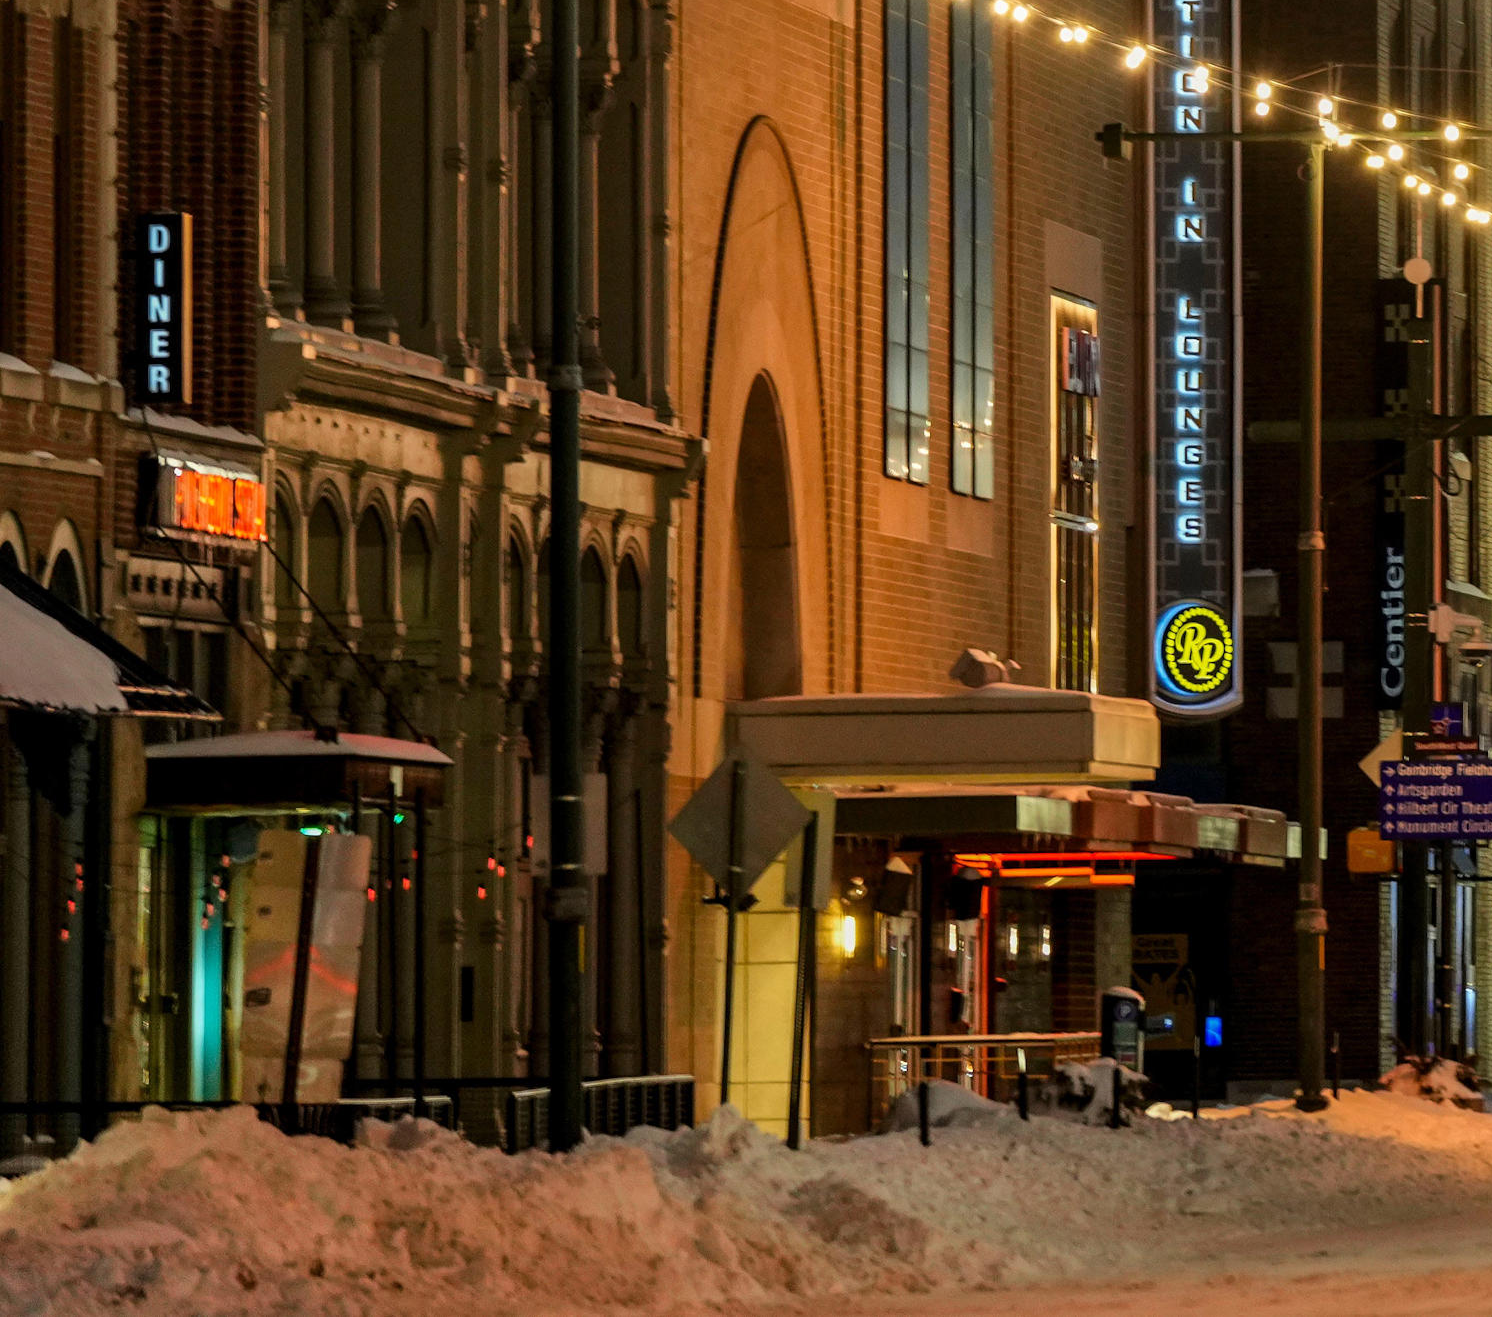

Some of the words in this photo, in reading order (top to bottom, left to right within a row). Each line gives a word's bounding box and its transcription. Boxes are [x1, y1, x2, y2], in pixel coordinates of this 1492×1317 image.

[1177, 179, 1203, 241] IN
[147, 224, 171, 394] DINER
[1177, 298, 1204, 540] LOUNGES
[1381, 546, 1405, 697] Centier
[1397, 820, 1459, 833] Monument
